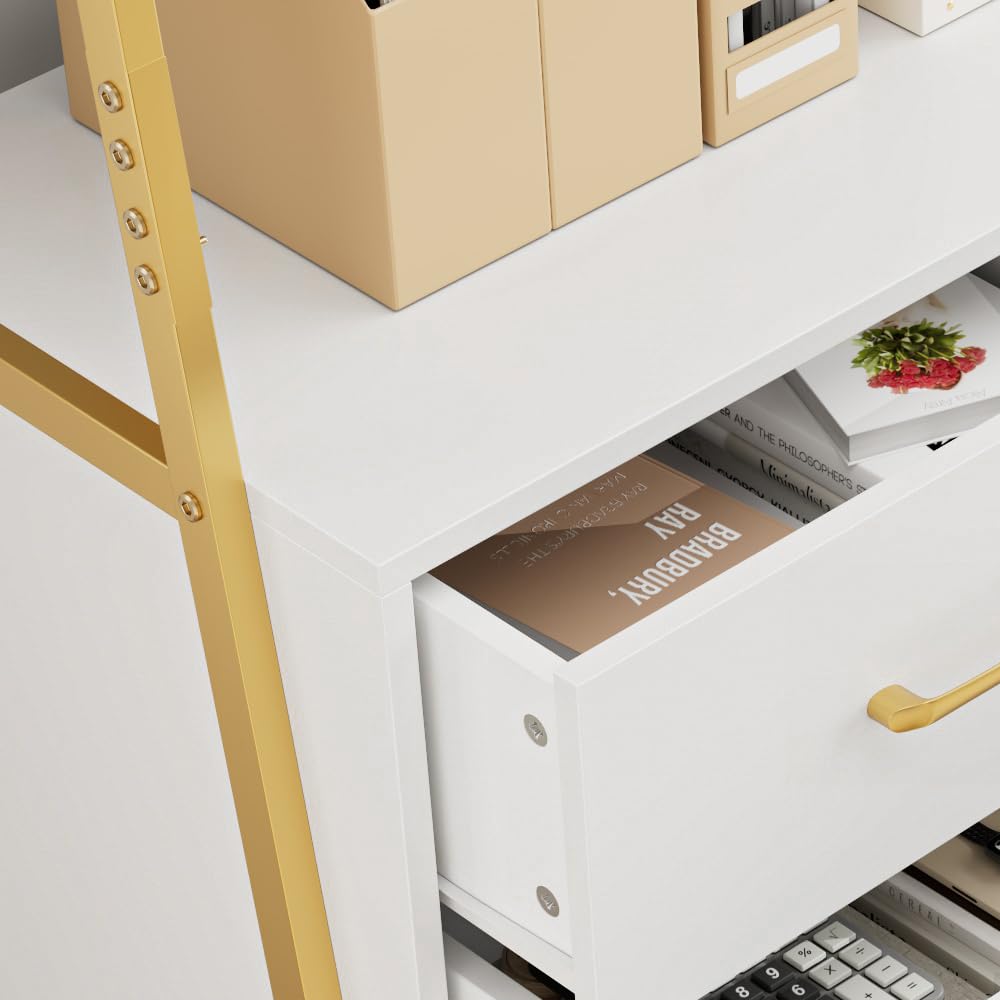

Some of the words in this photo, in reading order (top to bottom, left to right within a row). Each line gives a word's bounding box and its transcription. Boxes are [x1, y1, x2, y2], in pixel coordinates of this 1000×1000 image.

[734, 413, 754, 432] AND
[758, 426, 776, 446] THE
[778, 439, 853, 490] PHILOSOPHER'S
[644, 502, 702, 541] RAY
[607, 521, 743, 607] BRADBURY,
[735, 985, 750, 999] 8
[765, 966, 780, 980] 9
[791, 983, 806, 997] 6
